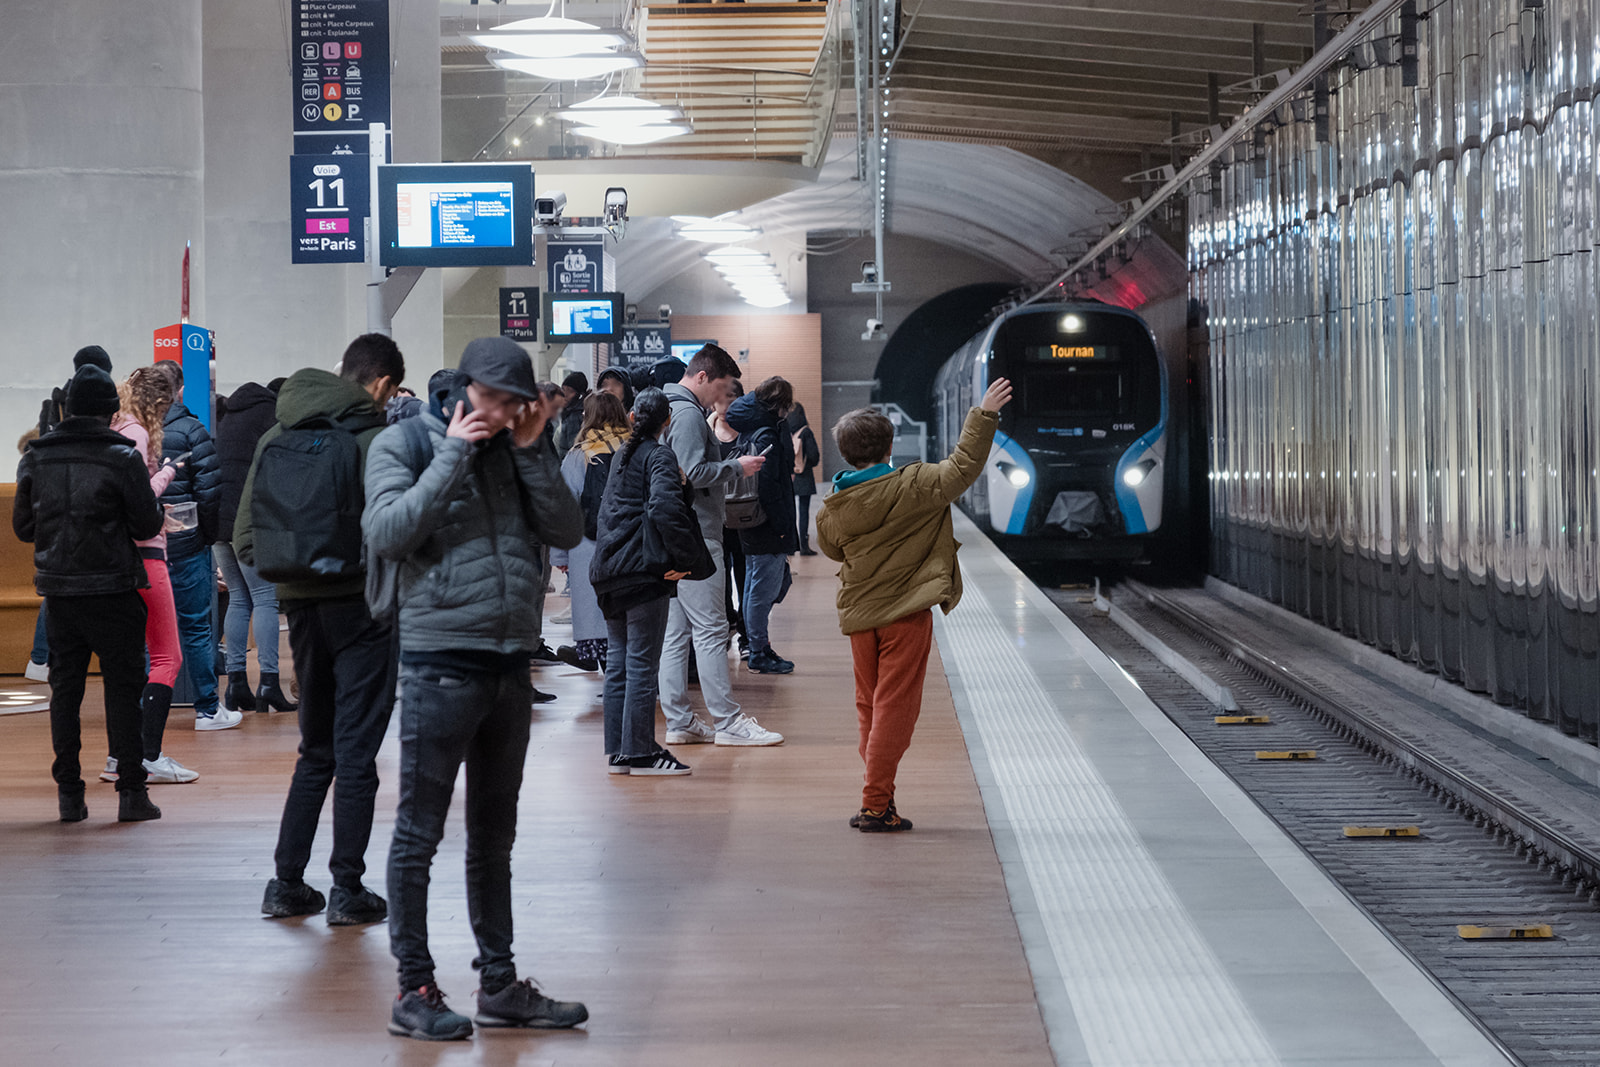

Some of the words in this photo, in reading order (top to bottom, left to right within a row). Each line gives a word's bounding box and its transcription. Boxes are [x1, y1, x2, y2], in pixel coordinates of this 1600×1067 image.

[328, 46, 335, 55] L
[348, 45, 358, 55] U
[325, 67, 338, 76] T2
[304, 88, 318, 96] RER
[327, 86, 337, 97] A
[346, 87, 361, 95] BUS
[306, 107, 317, 118] M
[348, 104, 360, 119] P
[316, 166, 337, 174] Voie
[308, 178, 344, 207] 11
[319, 220, 336, 231] Est
[320, 237, 357, 251] Paris
[508, 299, 527, 315] 11
[514, 328, 534, 337] Paris
[155, 338, 179, 347] SOS
[1050, 344, 1095, 358] Tournan
